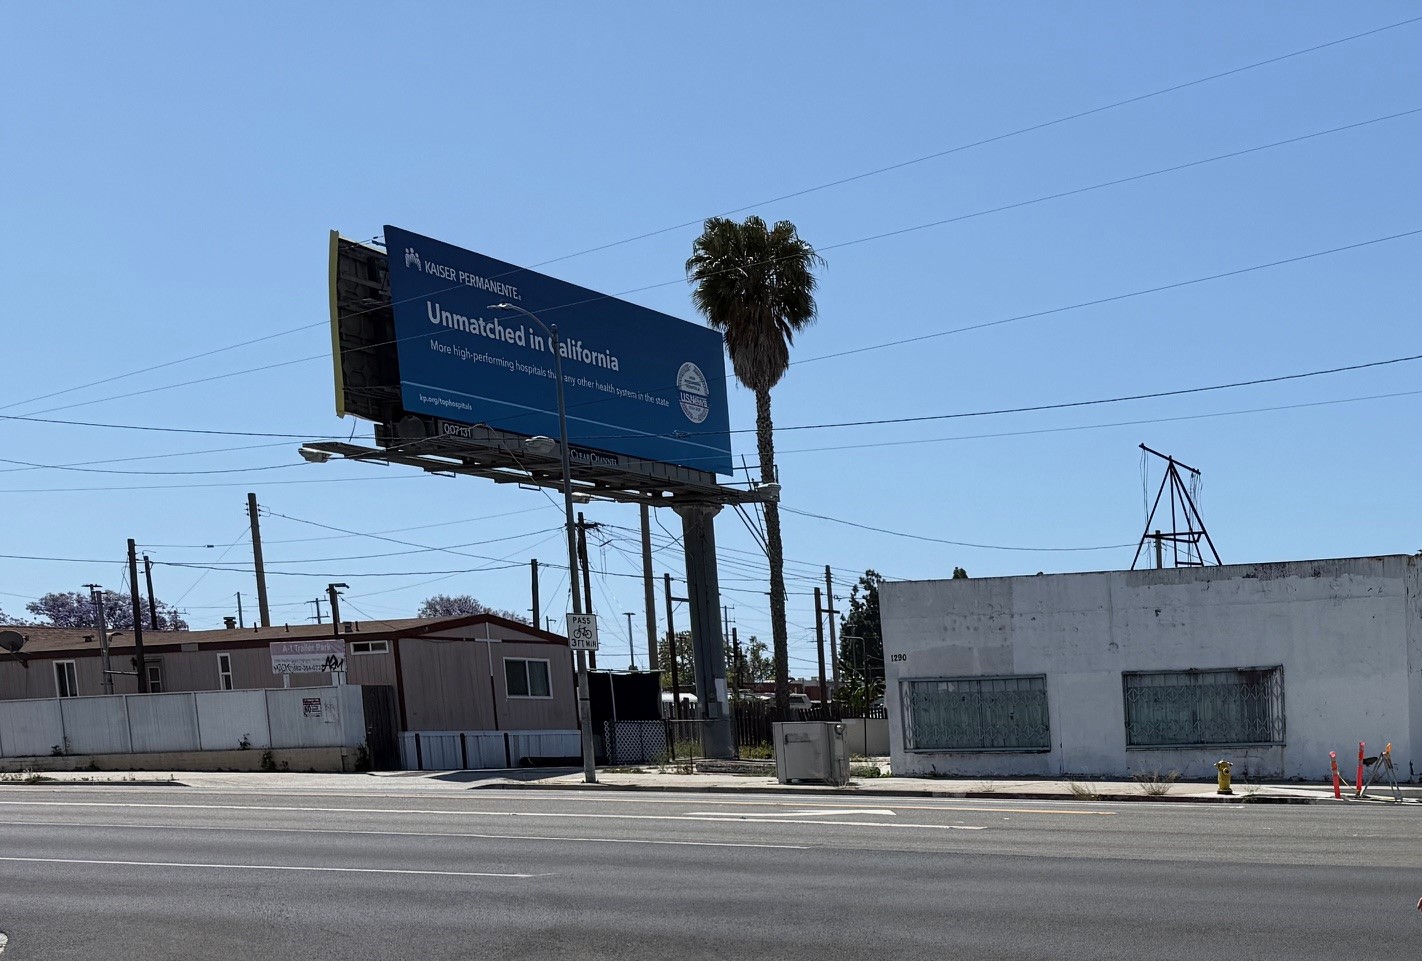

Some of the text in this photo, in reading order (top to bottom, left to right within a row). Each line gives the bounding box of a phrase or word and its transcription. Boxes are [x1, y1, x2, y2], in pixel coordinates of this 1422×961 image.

[424, 260, 518, 299] KAISER PERMANENTE
[426, 301, 526, 347] Unmatched
[529, 329, 544, 351] in
[430, 340, 452, 354] More
[453, 345, 515, 371] high-performing
[515, 360, 547, 378] hospitals
[564, 374, 576, 387] any
[577, 376, 594, 388] other
[595, 380, 615, 394] health
[616, 388, 637, 400] system
[644, 393, 654, 404] the
[655, 396, 670, 408] state
[419, 393, 473, 411] kp.org/tophospitals
[570, 449, 617, 465] CLEAR CHANNEL
[572, 616, 591, 624] PASS
[282, 642, 331, 653] A-1 Trailer Park
[571, 638, 577, 647] 3
[585, 640, 597, 648] MIN
[890, 653, 907, 662] 1290
